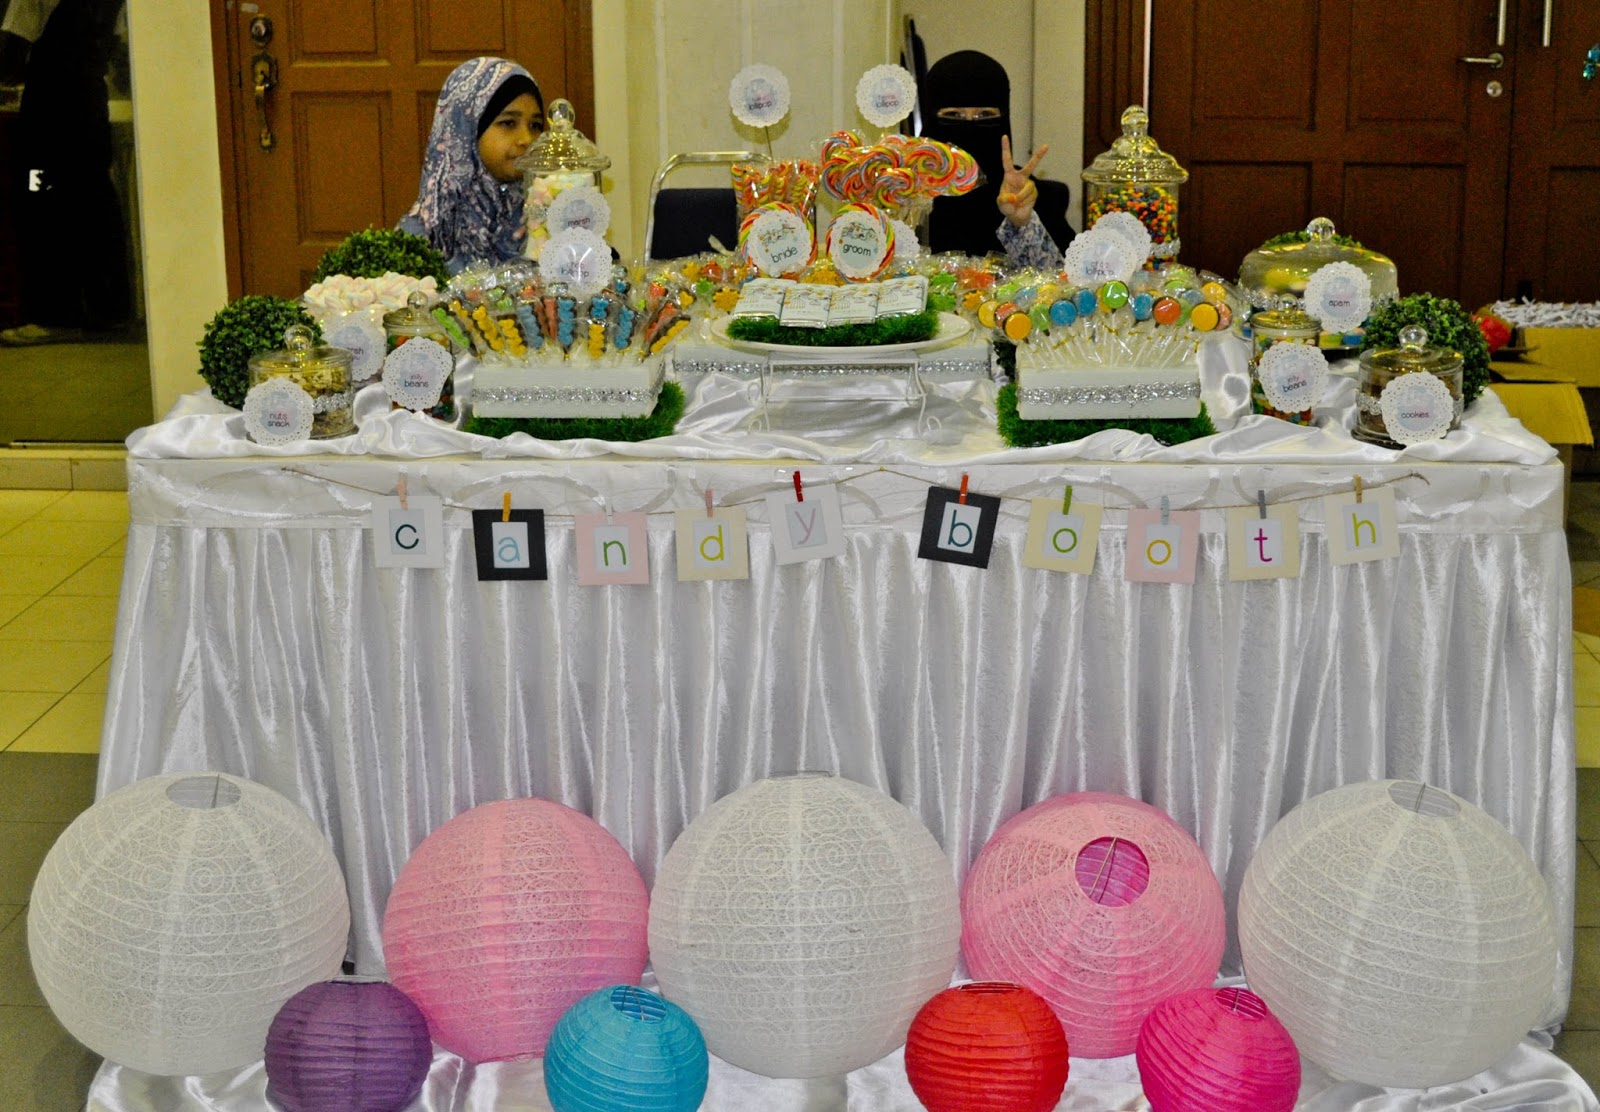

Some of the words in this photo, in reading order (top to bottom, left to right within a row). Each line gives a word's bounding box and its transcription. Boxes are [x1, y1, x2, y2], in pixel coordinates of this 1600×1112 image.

[748, 101, 772, 111] lollipop
[876, 101, 899, 109] lollipop
[568, 217, 591, 227] marsh
[770, 245, 798, 263] bride
[842, 243, 872, 257] groom
[404, 380, 429, 388] beans
[1282, 379, 1307, 393] beans
[269, 412, 288, 420] nuts
[1400, 410, 1430, 419] cookies
[267, 419, 290, 428] snack
